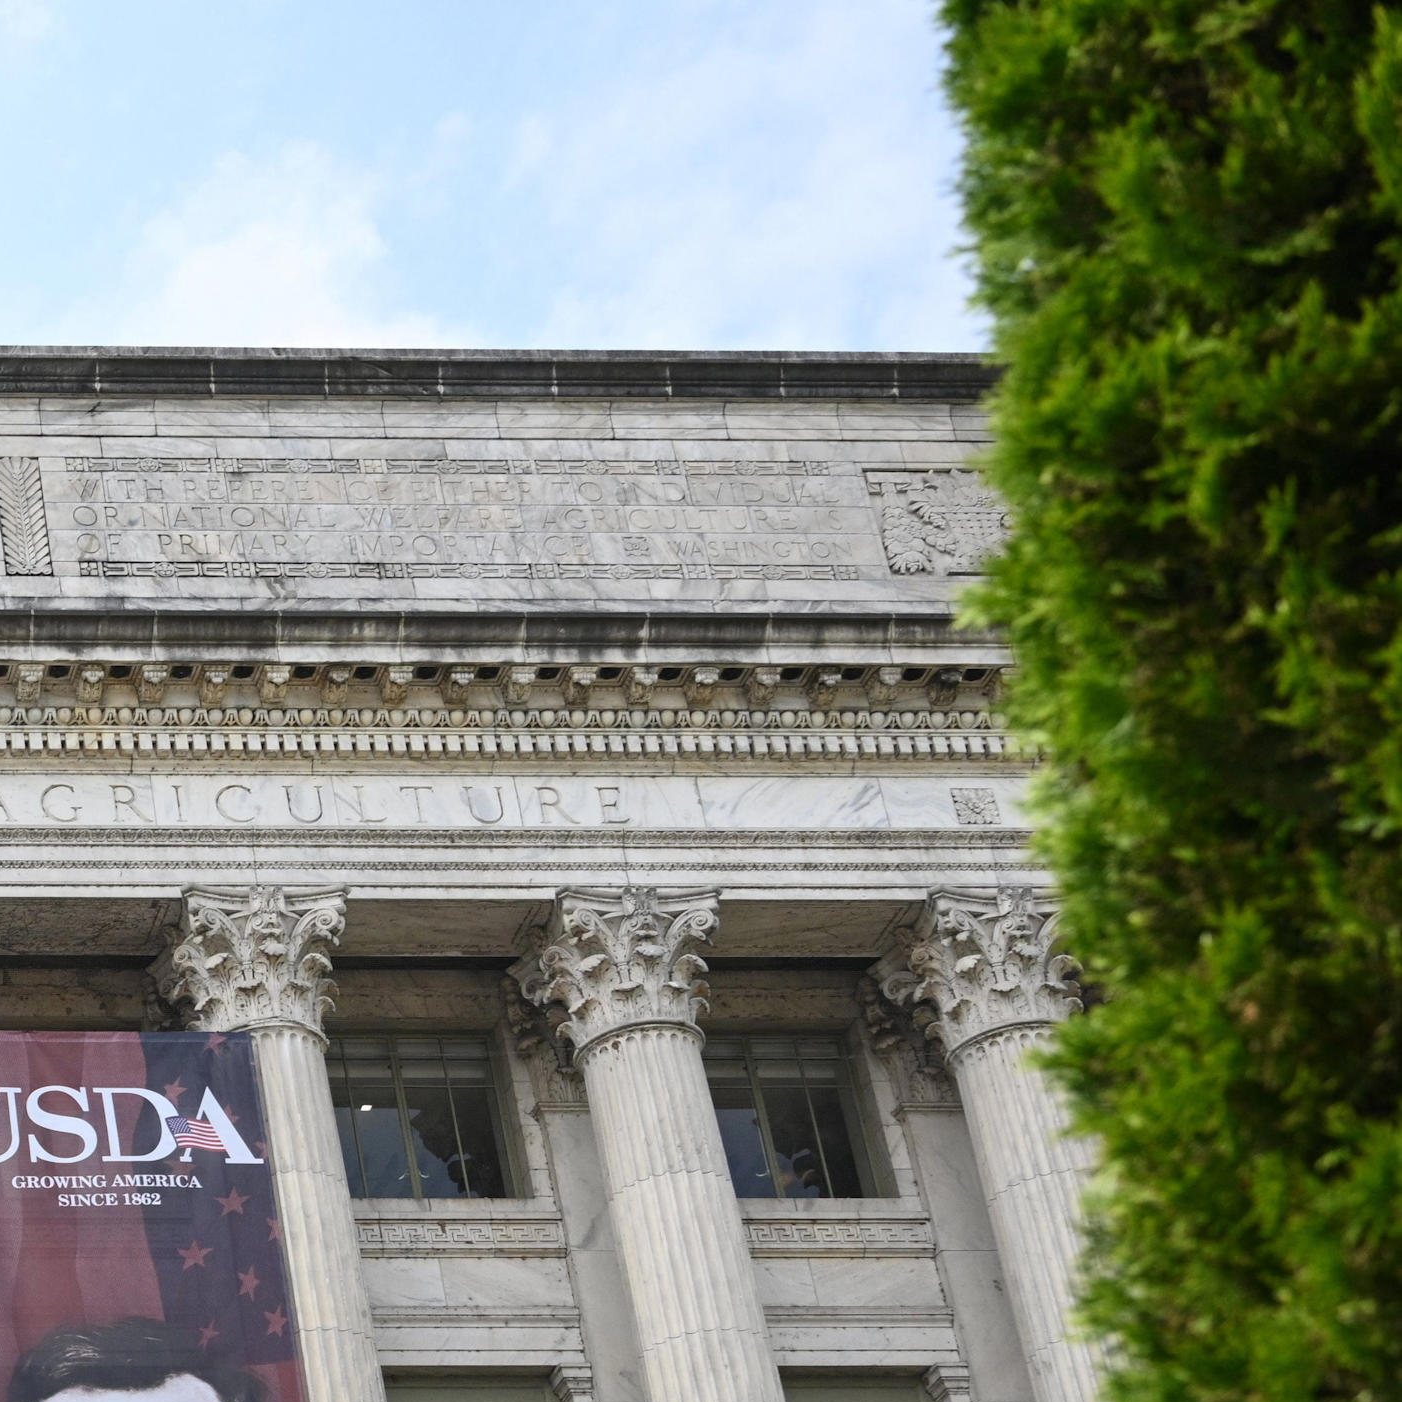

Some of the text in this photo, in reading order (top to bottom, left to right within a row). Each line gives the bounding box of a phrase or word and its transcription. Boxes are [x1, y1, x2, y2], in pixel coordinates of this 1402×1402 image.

[70, 479, 841, 503] WITH REFERENCE EITHER TO INDIVIDUAL
[73, 506, 845, 531] OR NATIONAL WELFARE AGRICULTURE IS
[76, 533, 855, 558] OF PRIMARY IMPORTANCE WASHINGTON
[12, 1174, 202, 1189] GROWING AMERICA
[58, 1193, 161, 1207] SINCE 1862
